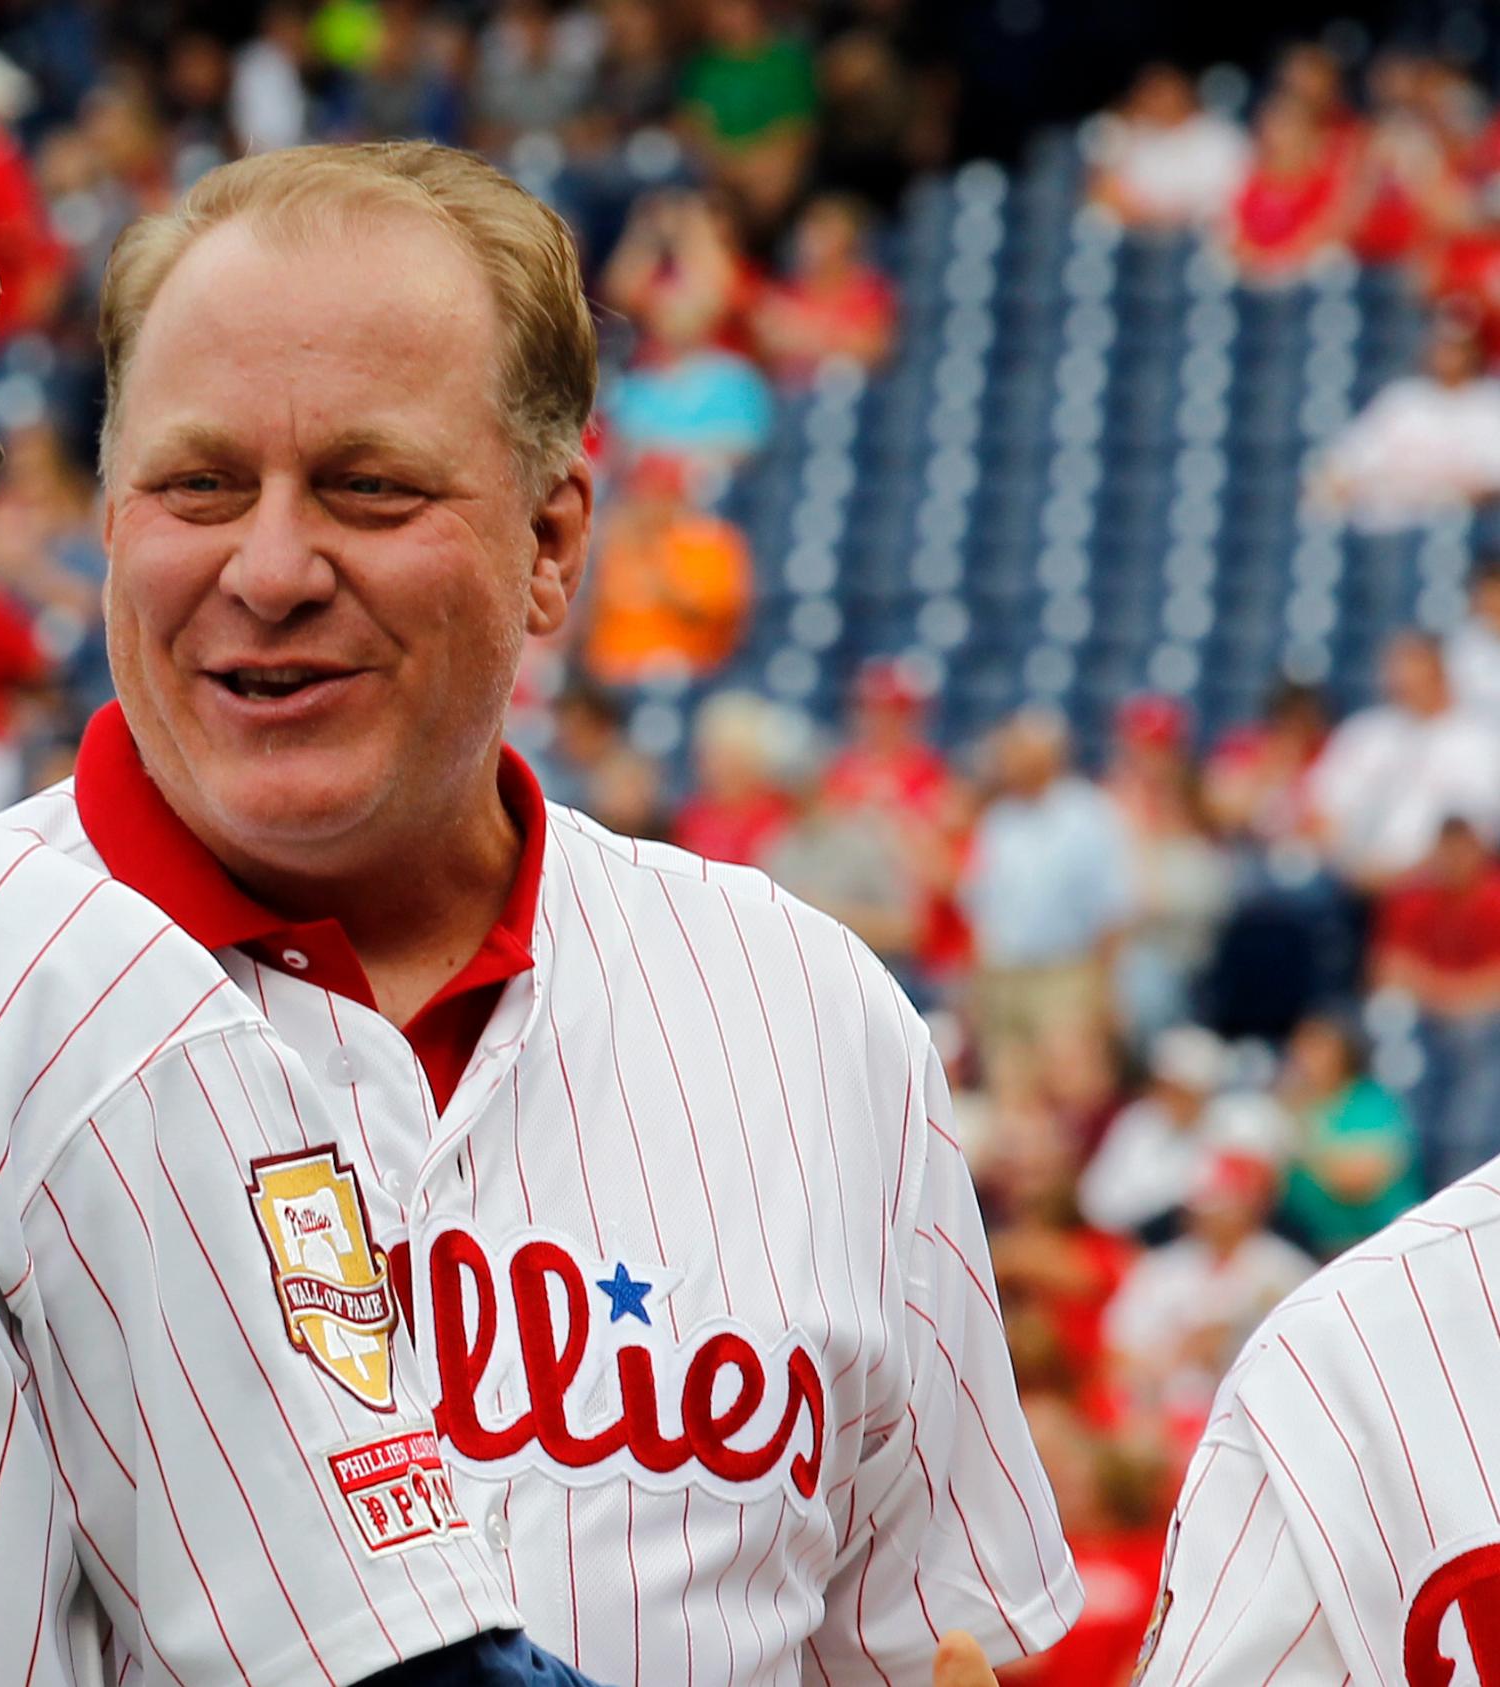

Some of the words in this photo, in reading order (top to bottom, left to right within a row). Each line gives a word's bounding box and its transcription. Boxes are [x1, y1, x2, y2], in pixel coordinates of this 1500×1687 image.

[284, 1206, 332, 1237] Phillies
[286, 1281, 324, 1307] WALL
[323, 1288, 343, 1313] OF
[344, 1293, 384, 1320] FAME
[388, 1229, 824, 1499] llies
[336, 1441, 410, 1483] PHILLIES
